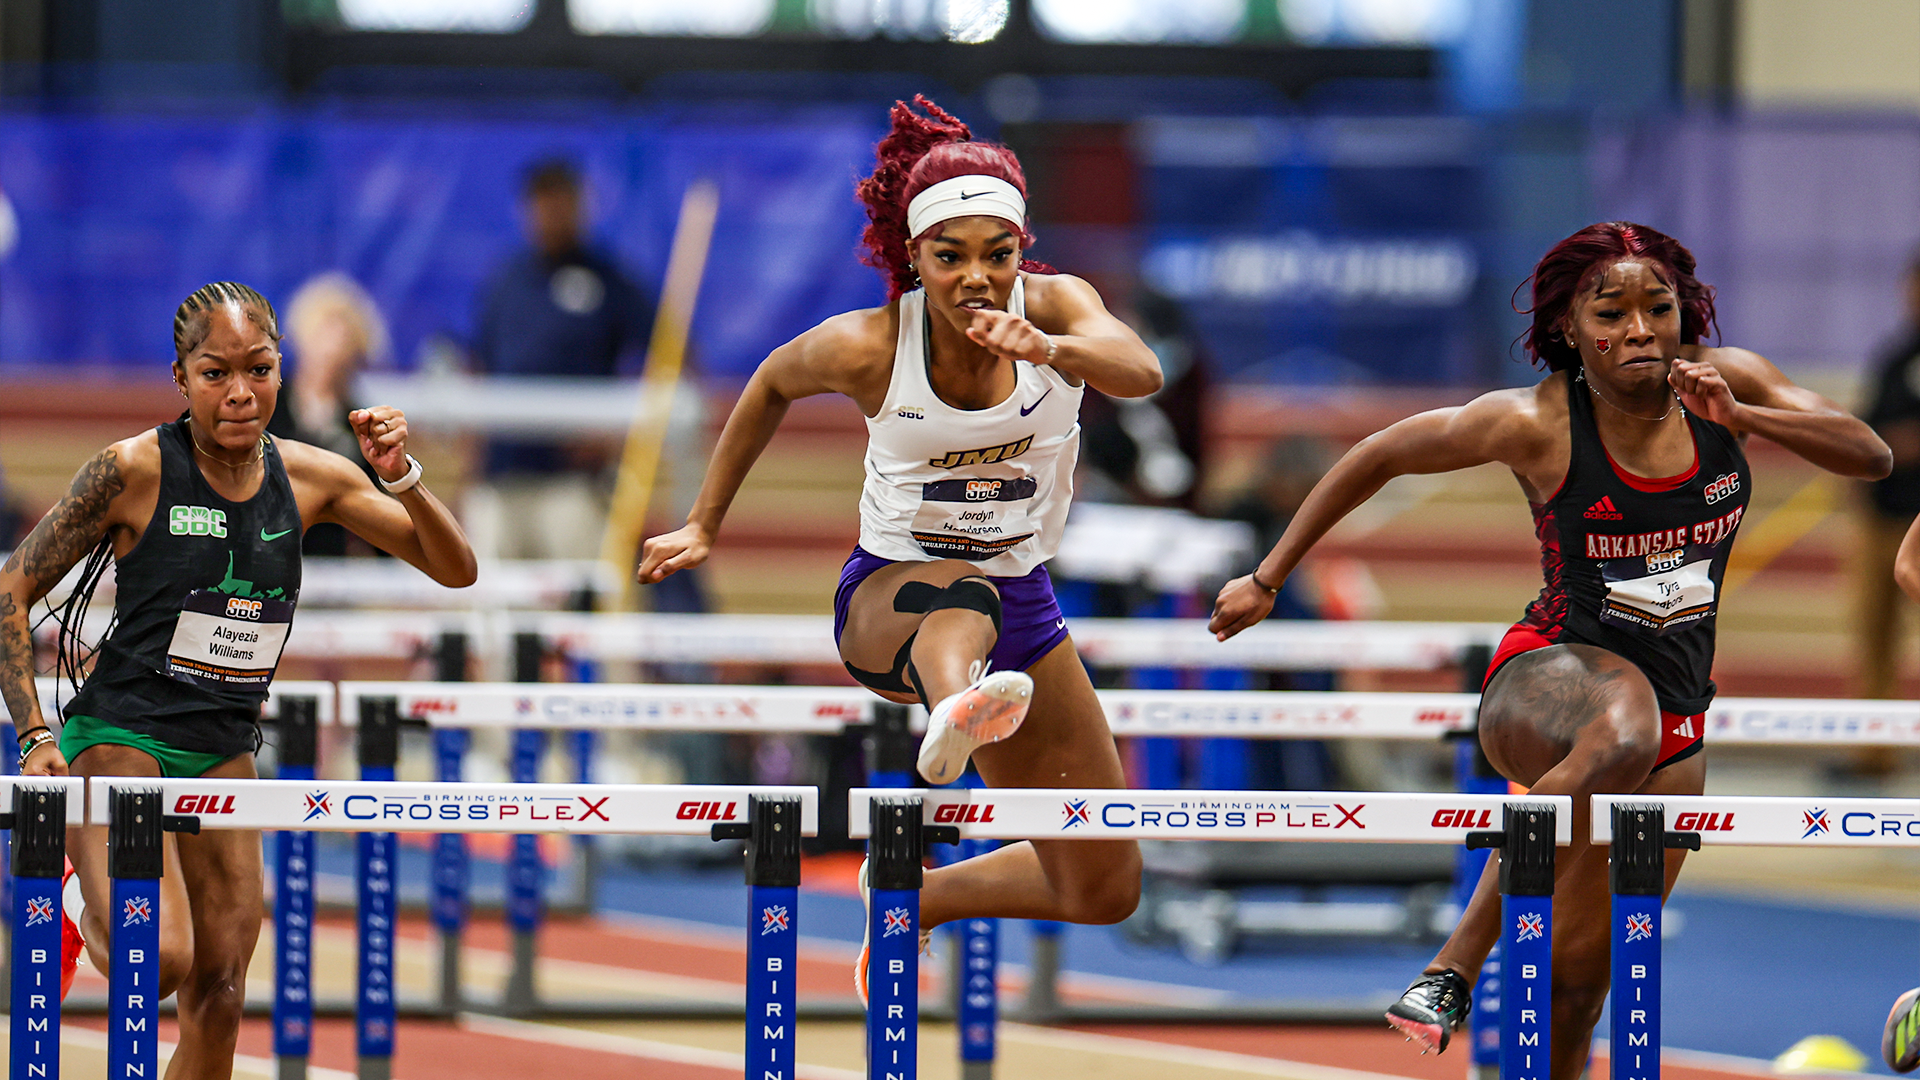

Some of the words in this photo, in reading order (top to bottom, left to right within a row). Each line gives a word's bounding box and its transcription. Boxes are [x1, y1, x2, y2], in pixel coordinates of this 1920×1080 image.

[898, 406, 924, 420] SBC
[929, 433, 1036, 469] JMU
[965, 480, 1001, 500] SBC
[1704, 472, 1741, 505] SBC
[169, 505, 227, 539] SBC
[958, 510, 994, 523] Jordyn
[1583, 511, 1624, 521] adidas
[1586, 526, 1687, 559] ARKANSAS
[1692, 504, 1744, 546] STATE
[917, 541, 947, 549] BRUARY
[1645, 549, 1684, 574] SBC
[1657, 581, 1680, 596] Tyra
[226, 598, 263, 620] SBC
[1607, 609, 1641, 623] FEBRUARY
[213, 626, 259, 643] Alayezia
[209, 642, 254, 661] Williams
[170, 664, 204, 678] FEBRUARY
[171, 658, 194, 668] INDOOR
[174, 795, 236, 814] GILL
[424, 794, 534, 803] BIRMINGHAM
[1181, 802, 1291, 811] BIRMINGHAM
[676, 802, 737, 821] GILL
[934, 804, 995, 824] GILL
[1431, 809, 1492, 828] GILL
[1674, 812, 1735, 831] GILL
[27, 949, 49, 1078] BIRMIN
[125, 949, 147, 1078] BIRMIN
[1519, 964, 1539, 1080] BIRMI
[1628, 964, 1649, 1080] BIRMI
